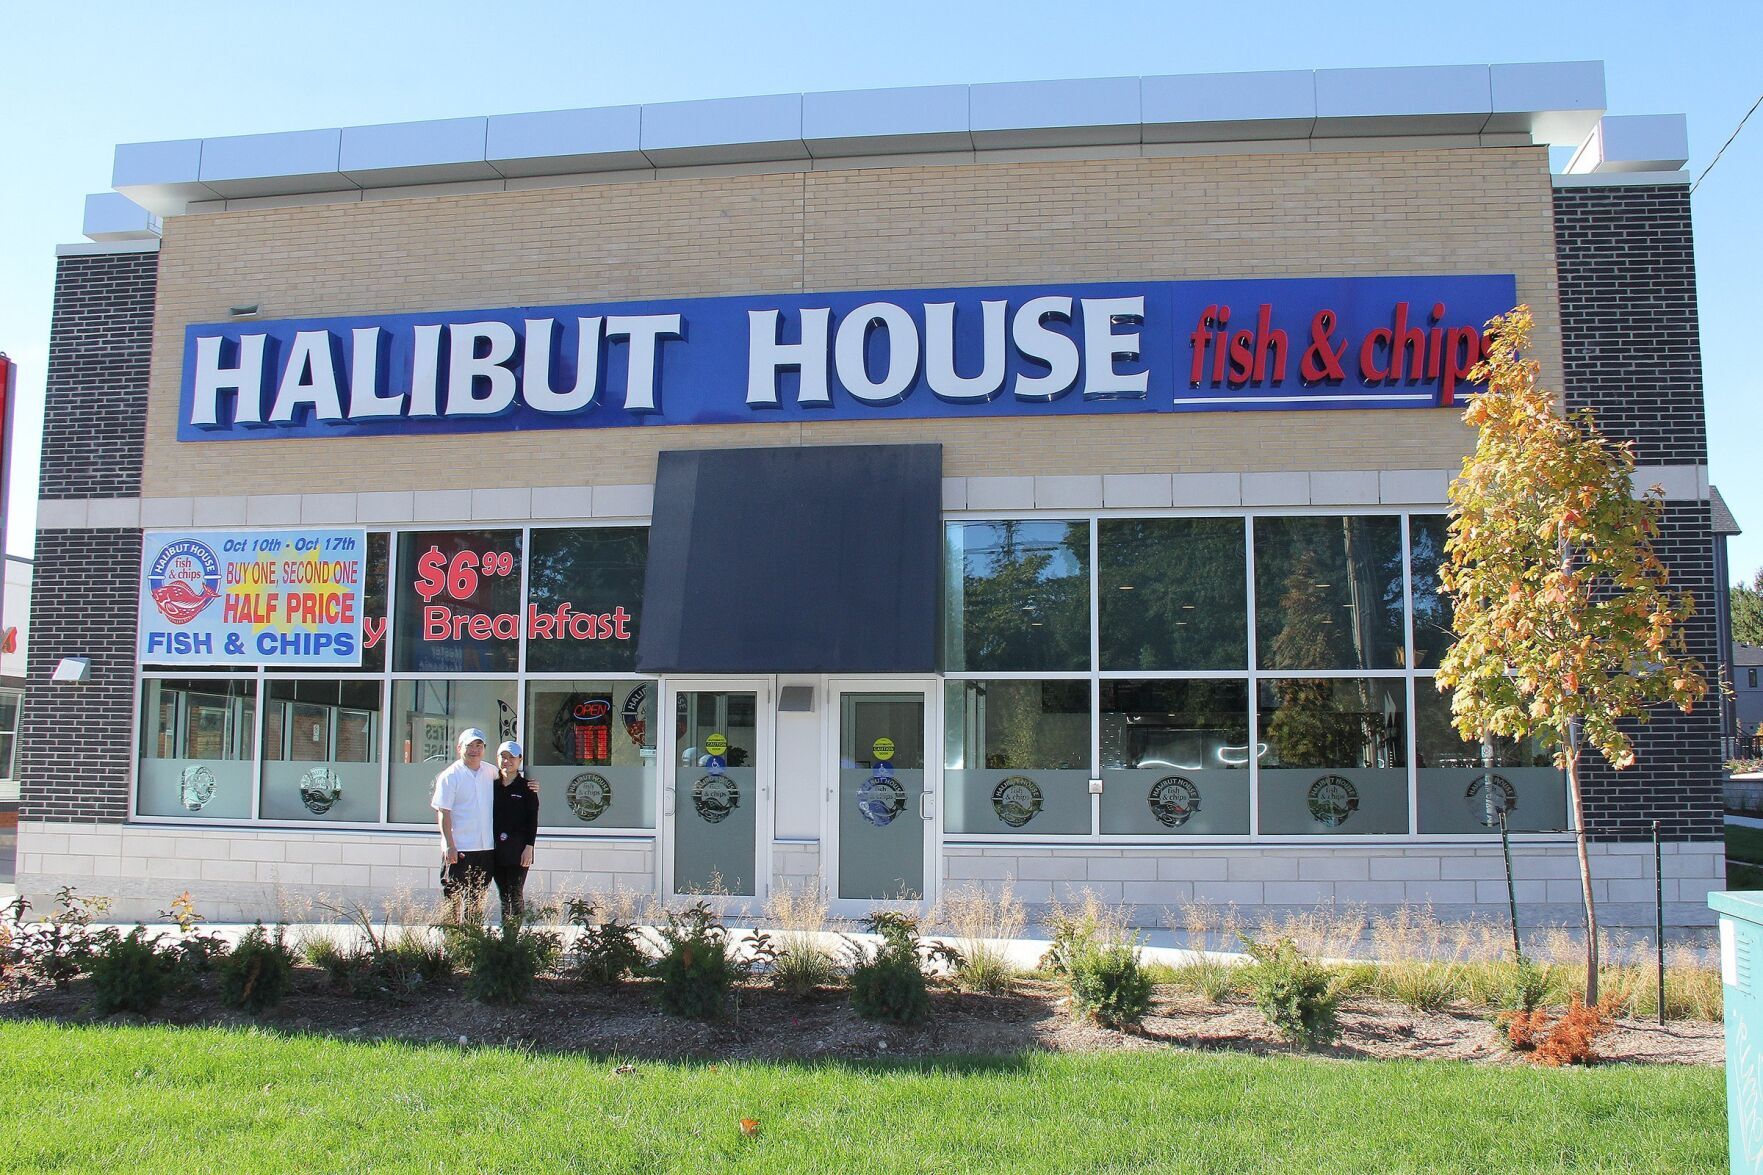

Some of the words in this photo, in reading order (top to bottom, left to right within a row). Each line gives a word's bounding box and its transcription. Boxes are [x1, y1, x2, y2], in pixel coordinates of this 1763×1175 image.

[1190, 302, 1289, 386] fish
[1301, 308, 1349, 384] &
[190, 313, 684, 427] HALIBUT
[746, 295, 1151, 407] HOUSE
[223, 539, 248, 552] Oct
[252, 538, 282, 552] 10th
[294, 537, 320, 551] Oct
[325, 536, 356, 551] 17th
[154, 543, 191, 573] HALIBUT
[190, 544, 215, 573] HOUSE
[175, 557, 192, 568] fish
[168, 569, 176, 579] &
[177, 568, 202, 581] chips
[226, 562, 251, 584] BUY
[251, 561, 279, 588] ONE,
[283, 560, 330, 584] SECOND
[333, 560, 359, 584] ONE
[223, 593, 279, 624] HALF
[286, 592, 355, 624] PRICE
[423, 602, 631, 641] Breakfast
[148, 632, 214, 655] FISH
[224, 632, 246, 656] &
[256, 632, 355, 656] CHIPS
[574, 704, 607, 716] OPEN
[1152, 778, 1177, 797] HALIBUT
[1178, 779, 1197, 797] HOUSE
